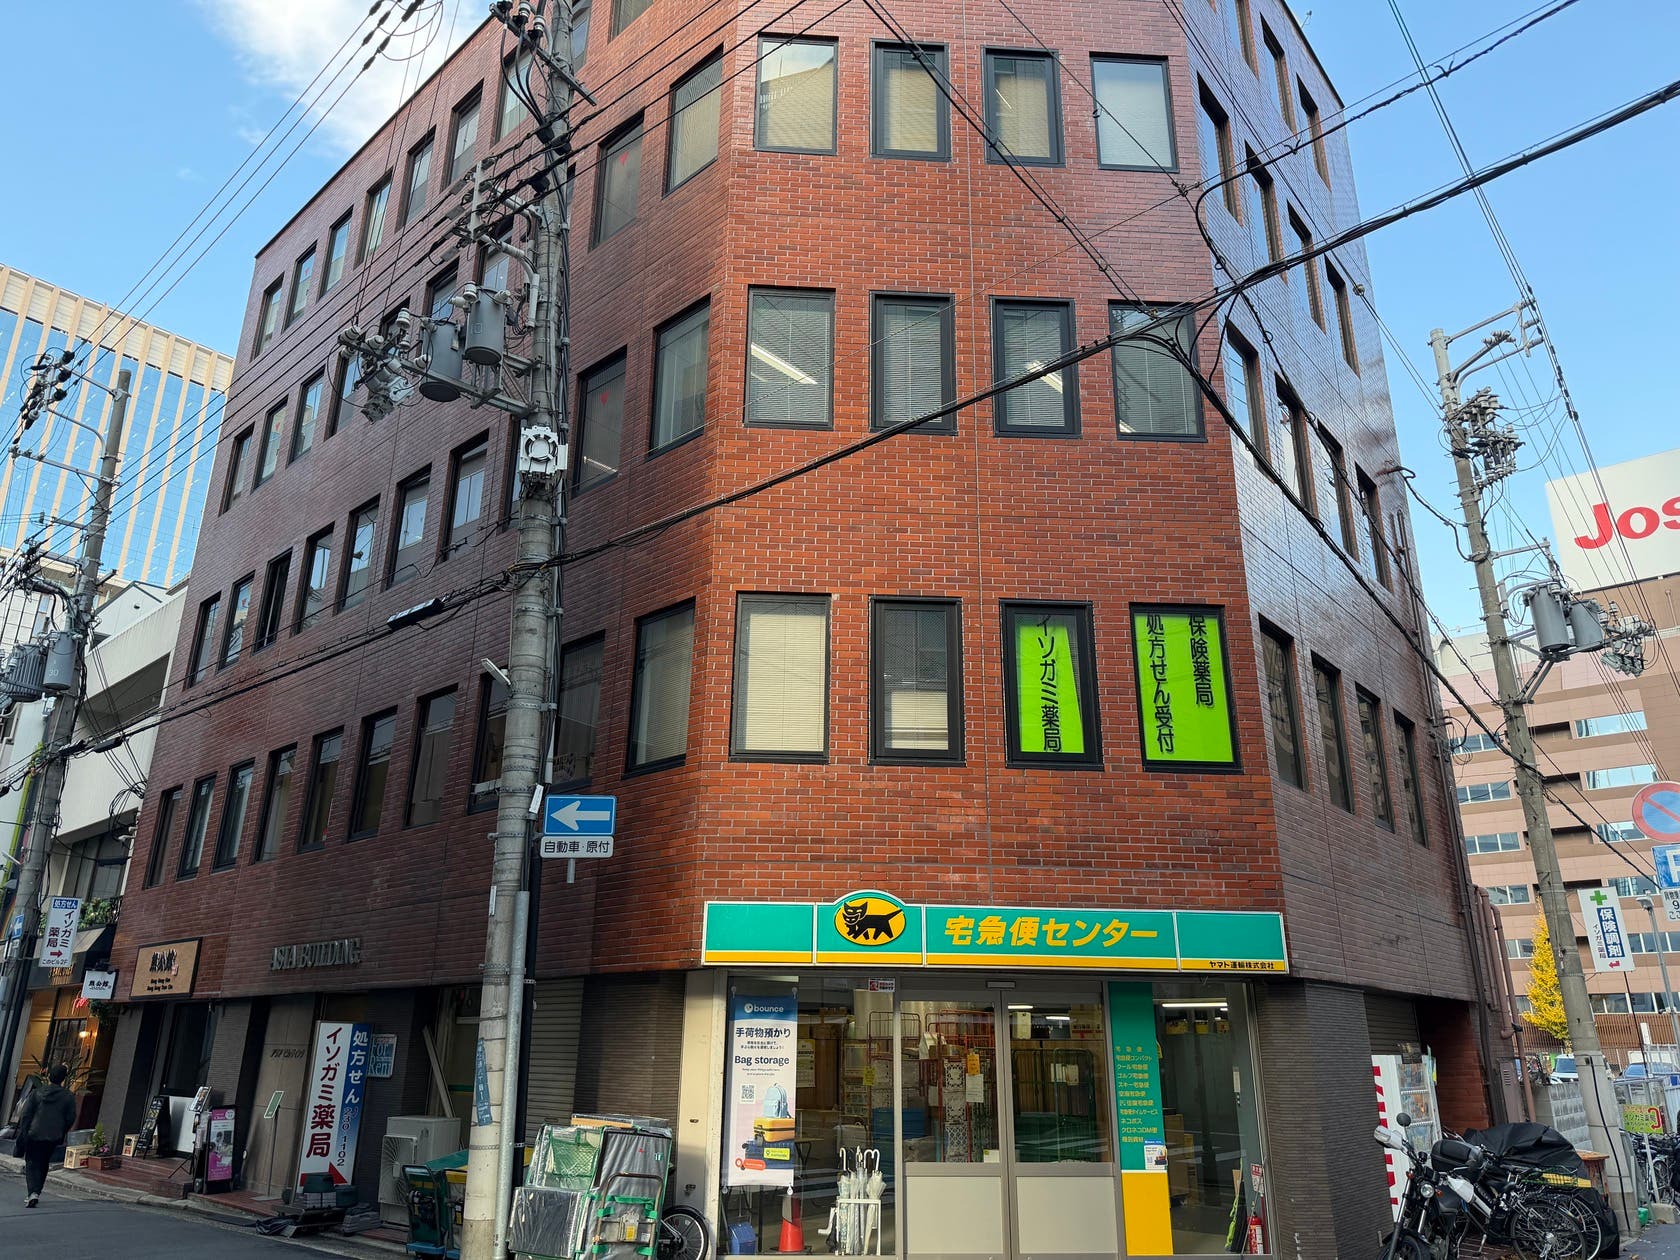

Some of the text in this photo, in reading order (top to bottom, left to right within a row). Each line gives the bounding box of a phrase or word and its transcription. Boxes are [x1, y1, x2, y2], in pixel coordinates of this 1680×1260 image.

[1188, 614, 1215, 708] 保険薬局
[1036, 614, 1062, 753] イソガミ薬局
[1146, 614, 1175, 755] 処方せん受付
[544, 840, 610, 854] 自動車・原付
[54, 900, 78, 909] 処方せん
[46, 927, 60, 948] 薬局
[59, 910, 74, 948] イソガミ
[944, 914, 1158, 947] 宅急便センター
[1599, 908, 1622, 957] 保険調剤
[1209, 960, 1275, 970] ヤマト運輸株式会社
[753, 1004, 784, 1013] bounce
[735, 1027, 791, 1038] 手荷物預かり
[345, 1030, 369, 1105] 処方せん
[734, 1055, 790, 1066] Bag storage
[306, 1026, 343, 1159] イソガミ薬局
